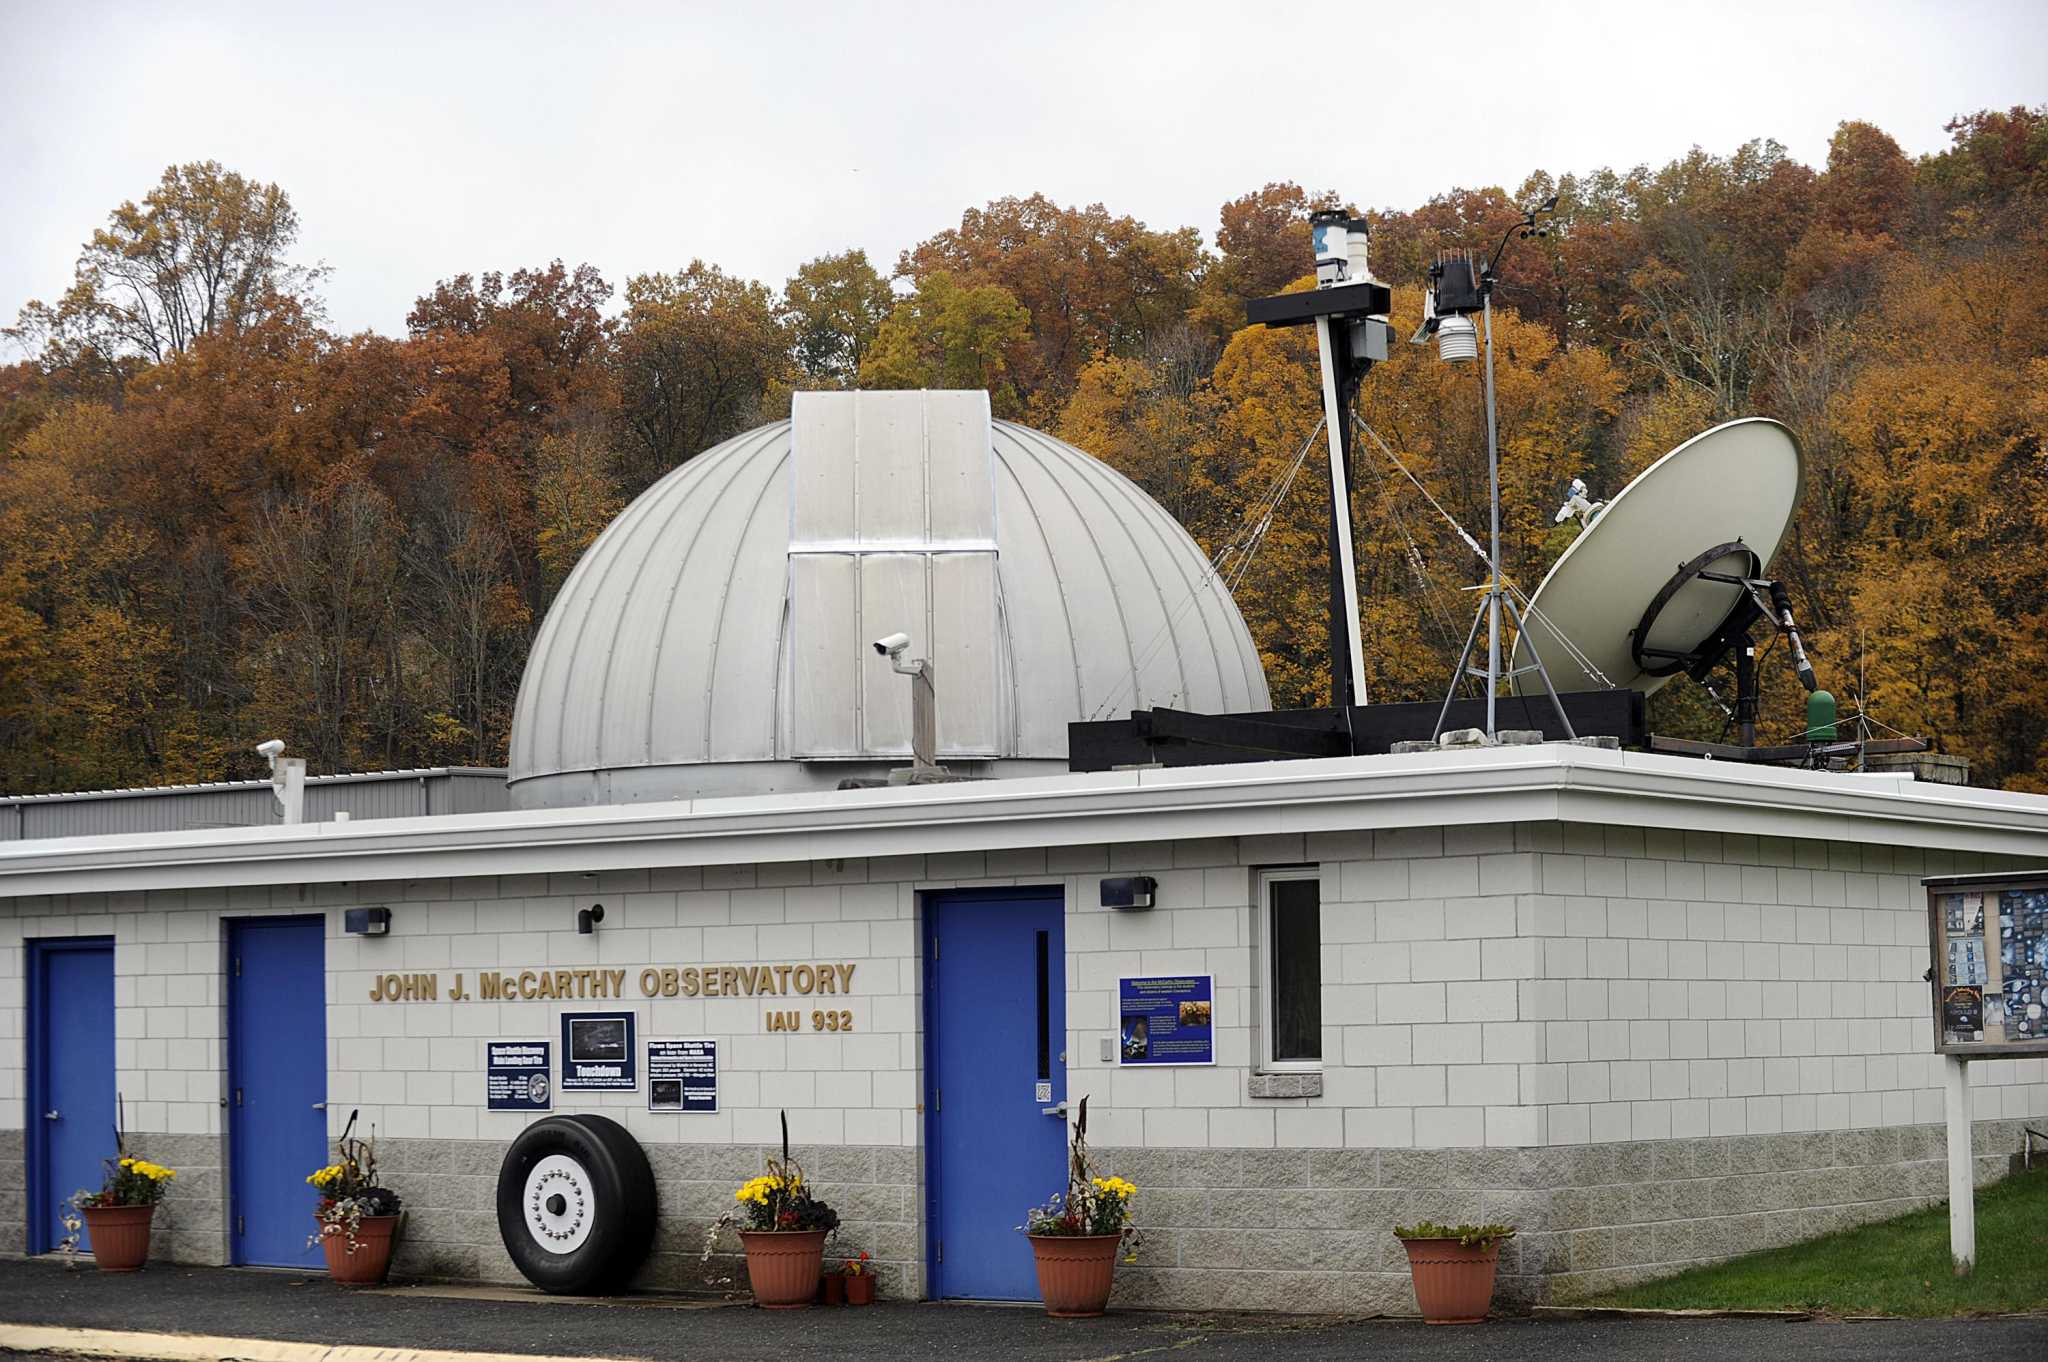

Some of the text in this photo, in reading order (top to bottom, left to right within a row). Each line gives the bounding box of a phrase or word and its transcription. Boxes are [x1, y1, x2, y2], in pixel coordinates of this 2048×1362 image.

[369, 964, 856, 1001] JOHN J. McCARTHY OBSERVATORY
[766, 1010, 853, 1032] IAU 932
